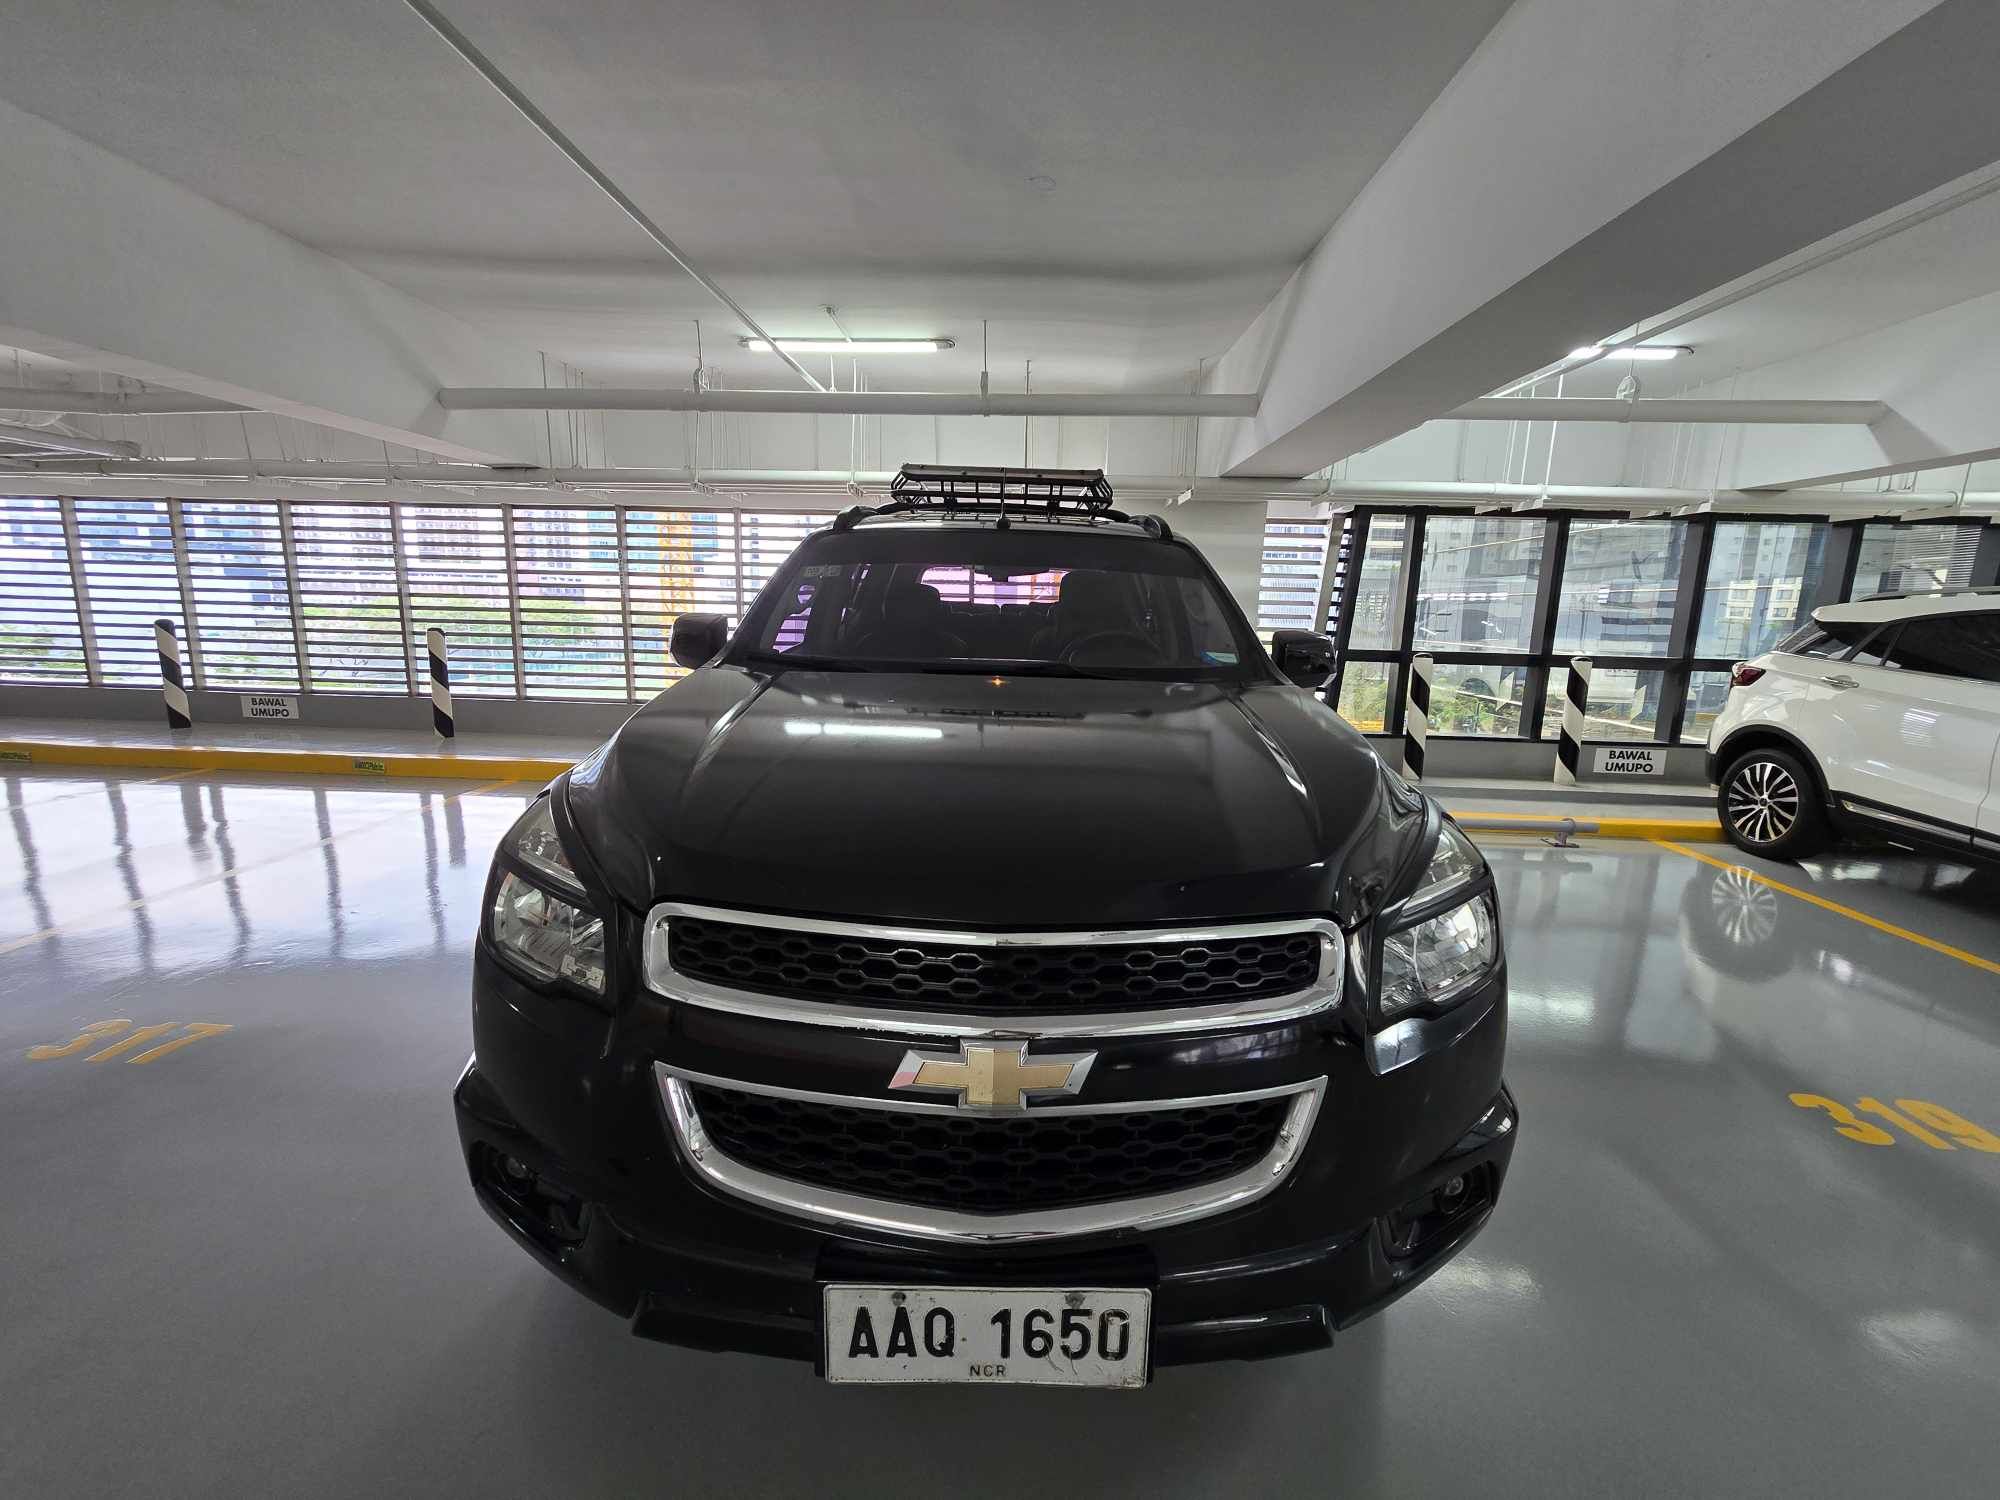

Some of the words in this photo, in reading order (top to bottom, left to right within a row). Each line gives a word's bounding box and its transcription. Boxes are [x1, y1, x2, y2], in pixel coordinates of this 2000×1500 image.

[251, 697, 287, 707] BAWAL
[251, 708, 290, 717] UMUPO
[1608, 750, 1653, 761] BAWAL
[1605, 762, 1654, 773] UMUPO
[848, 1305, 955, 1359] AAQ
[990, 1307, 1130, 1361] 1650
[969, 1364, 1007, 1378] NCR
